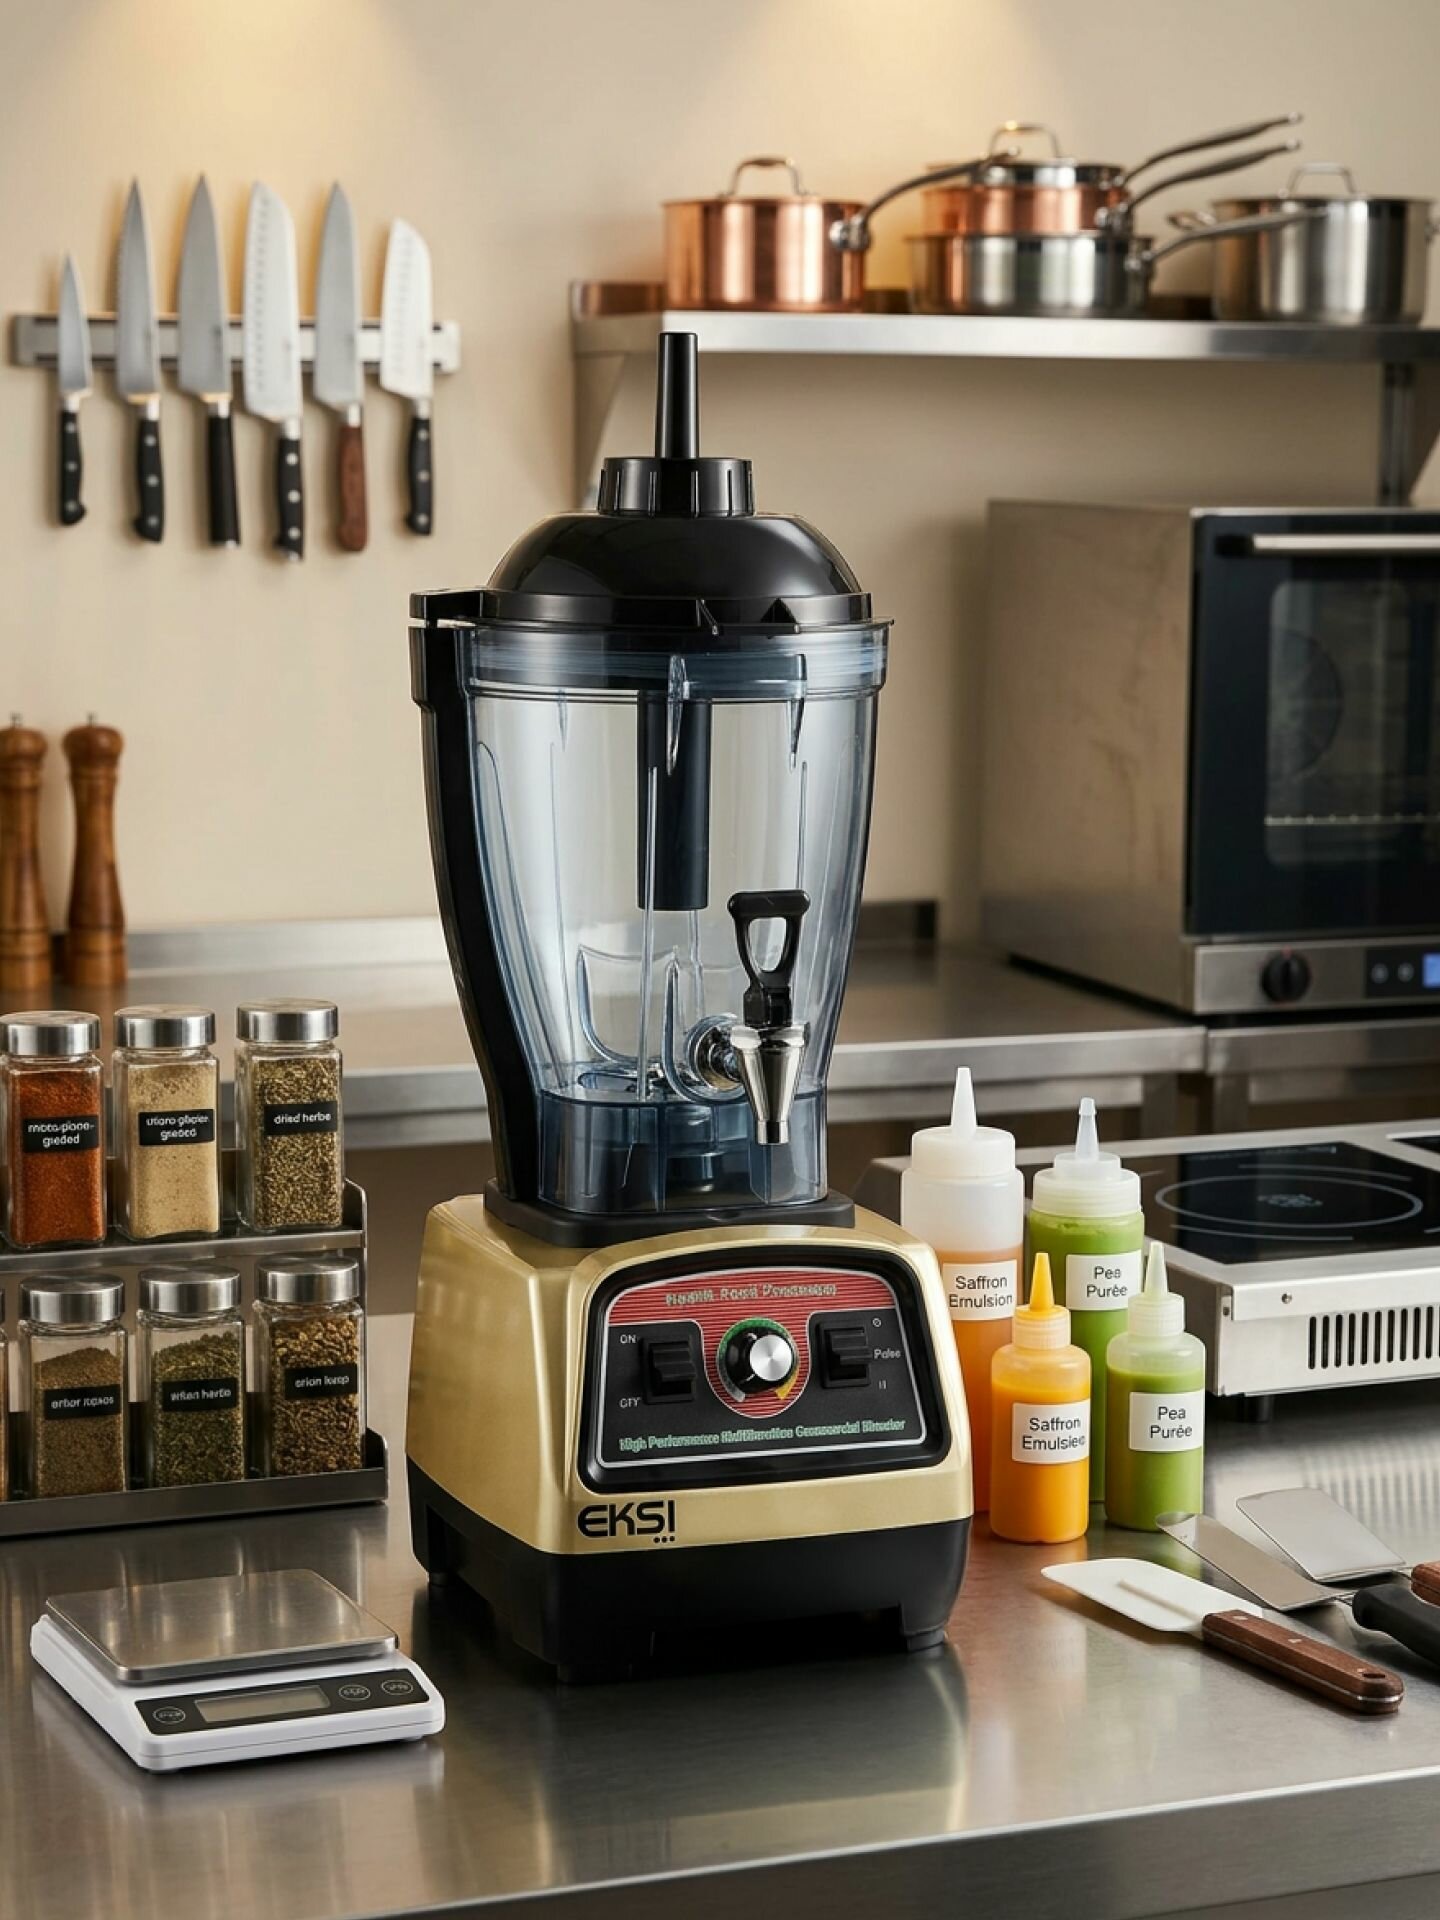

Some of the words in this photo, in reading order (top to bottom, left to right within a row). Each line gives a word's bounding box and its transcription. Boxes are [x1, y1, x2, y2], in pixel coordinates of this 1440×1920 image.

[955, 1275, 1008, 1290] Saffron
[949, 1293, 1013, 1308] Emulsion
[620, 1334, 637, 1344] ON
[1157, 1405, 1186, 1421] Pea
[1029, 1416, 1081, 1432] Saffron
[1150, 1424, 1193, 1439] Purée
